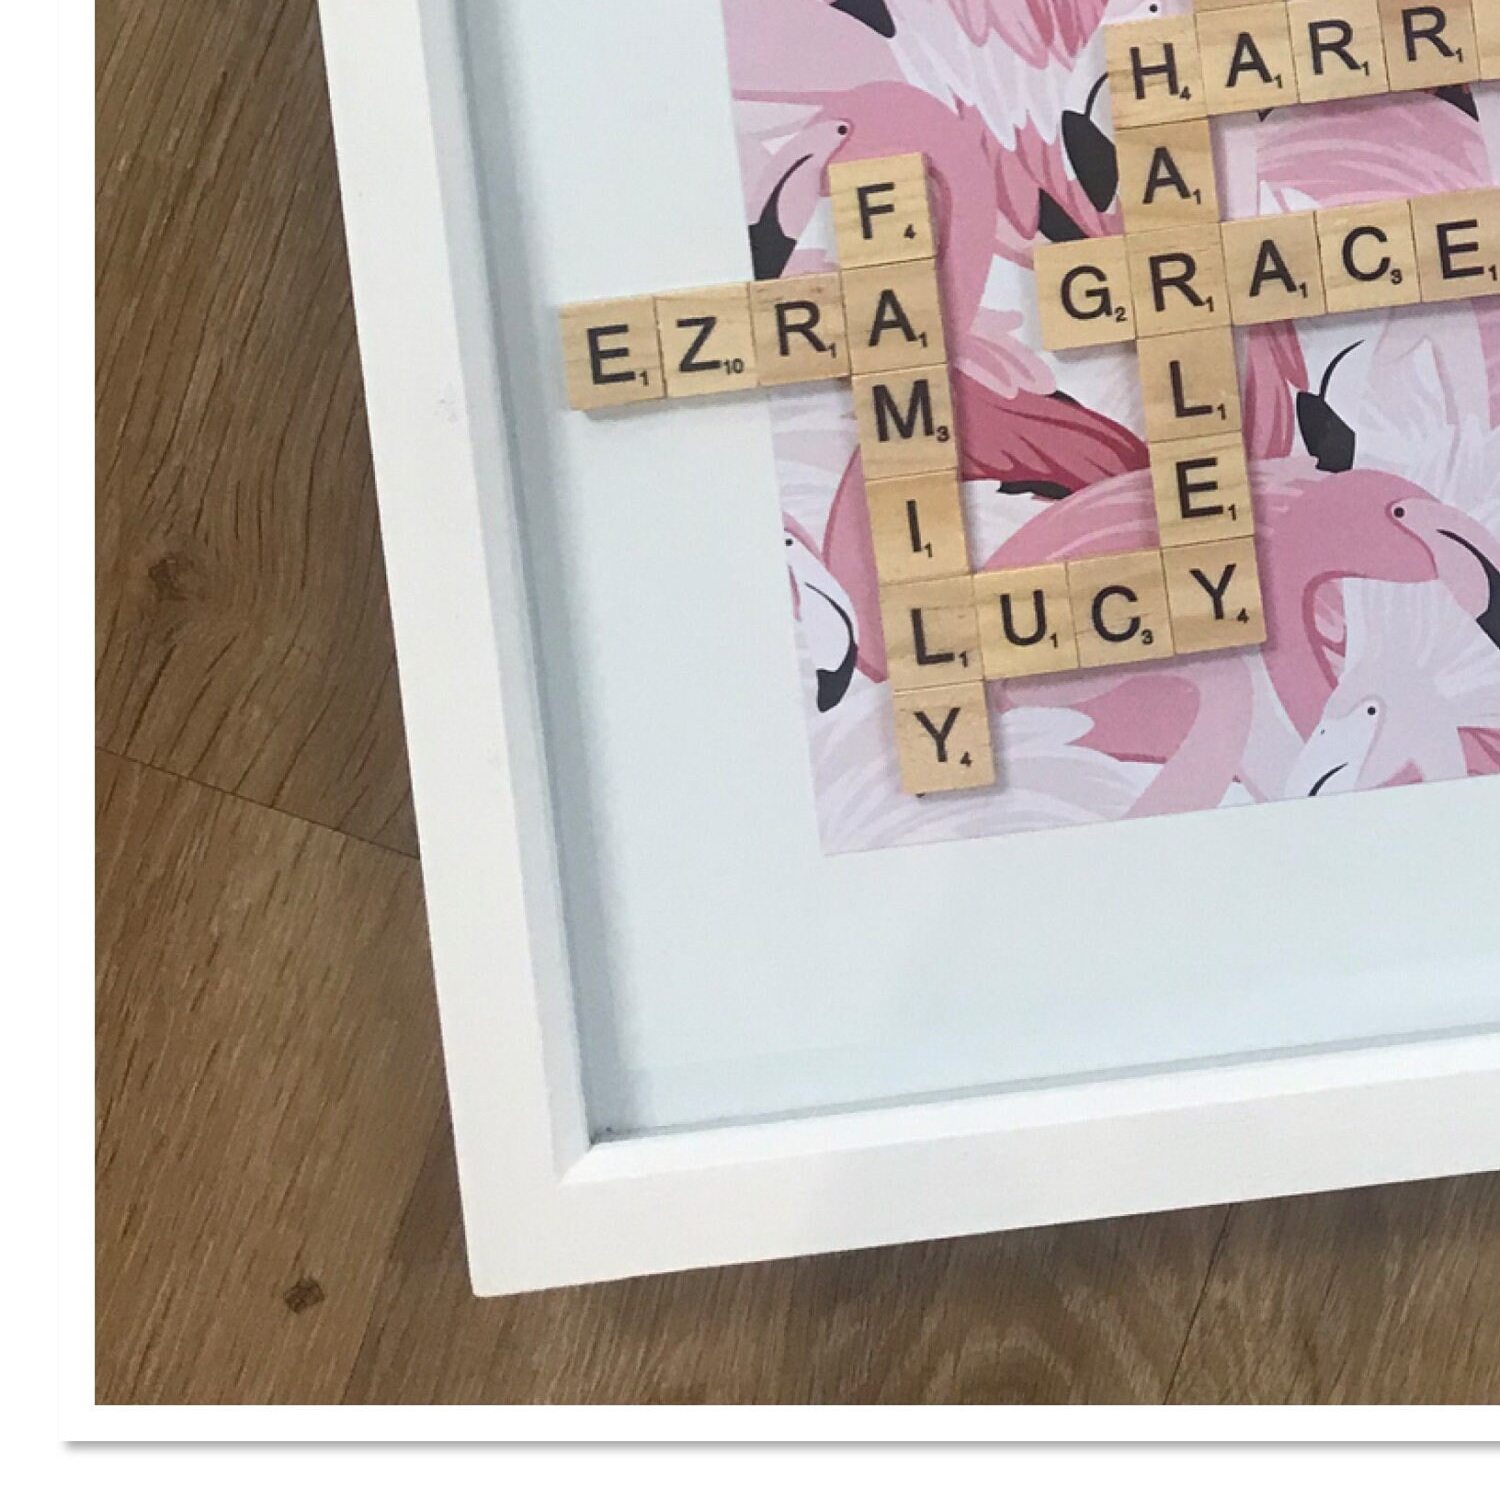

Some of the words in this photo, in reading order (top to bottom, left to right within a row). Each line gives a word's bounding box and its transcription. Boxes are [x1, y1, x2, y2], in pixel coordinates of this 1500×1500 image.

[1059, 218, 1486, 321] GRACE
[585, 288, 919, 386] EZRA
[1128, 41, 1238, 622] HARLEY
[855, 180, 962, 764] FAMILY
[909, 562, 1238, 667] LUCY
